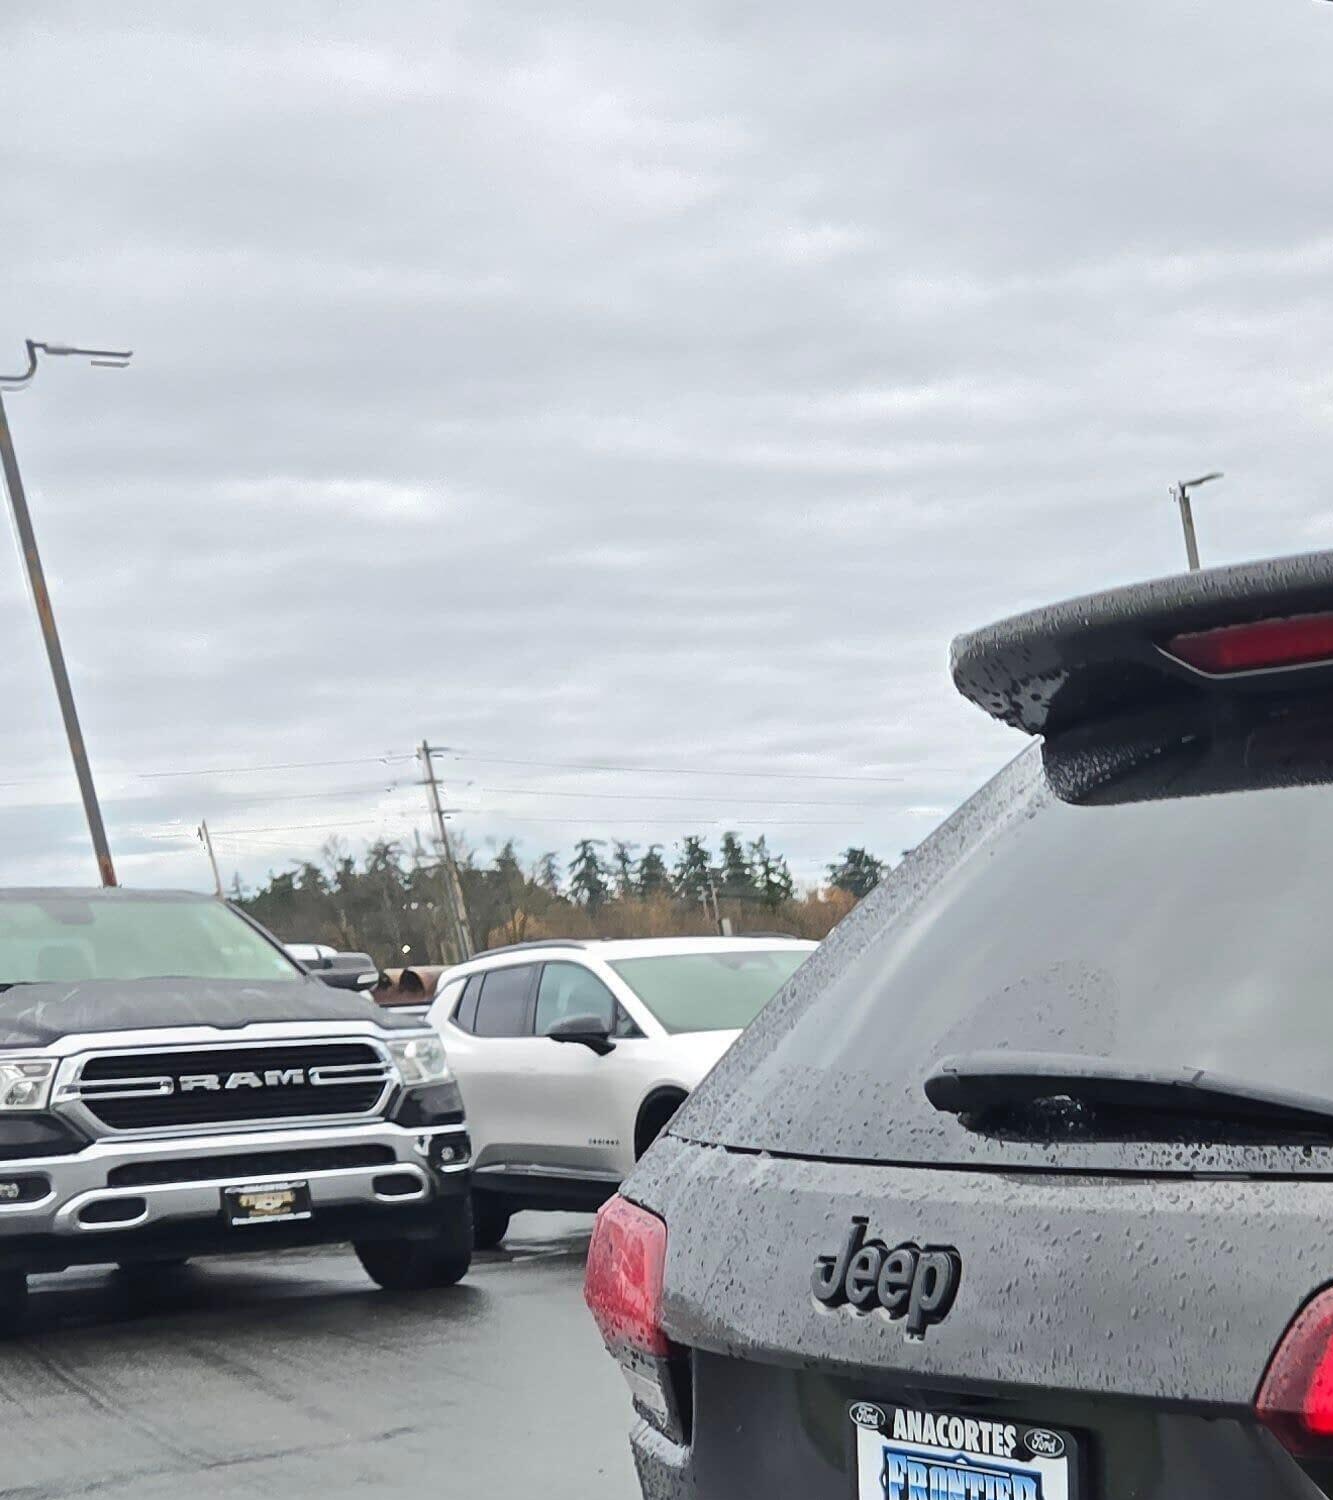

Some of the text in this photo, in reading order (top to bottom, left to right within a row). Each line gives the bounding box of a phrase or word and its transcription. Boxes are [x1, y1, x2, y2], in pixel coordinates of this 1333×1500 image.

[179, 1069, 305, 1092] RAM
[810, 1215, 963, 1341] Jeep
[893, 1408, 1017, 1458] ANACORTES
[1031, 1430, 1058, 1453] Ford
